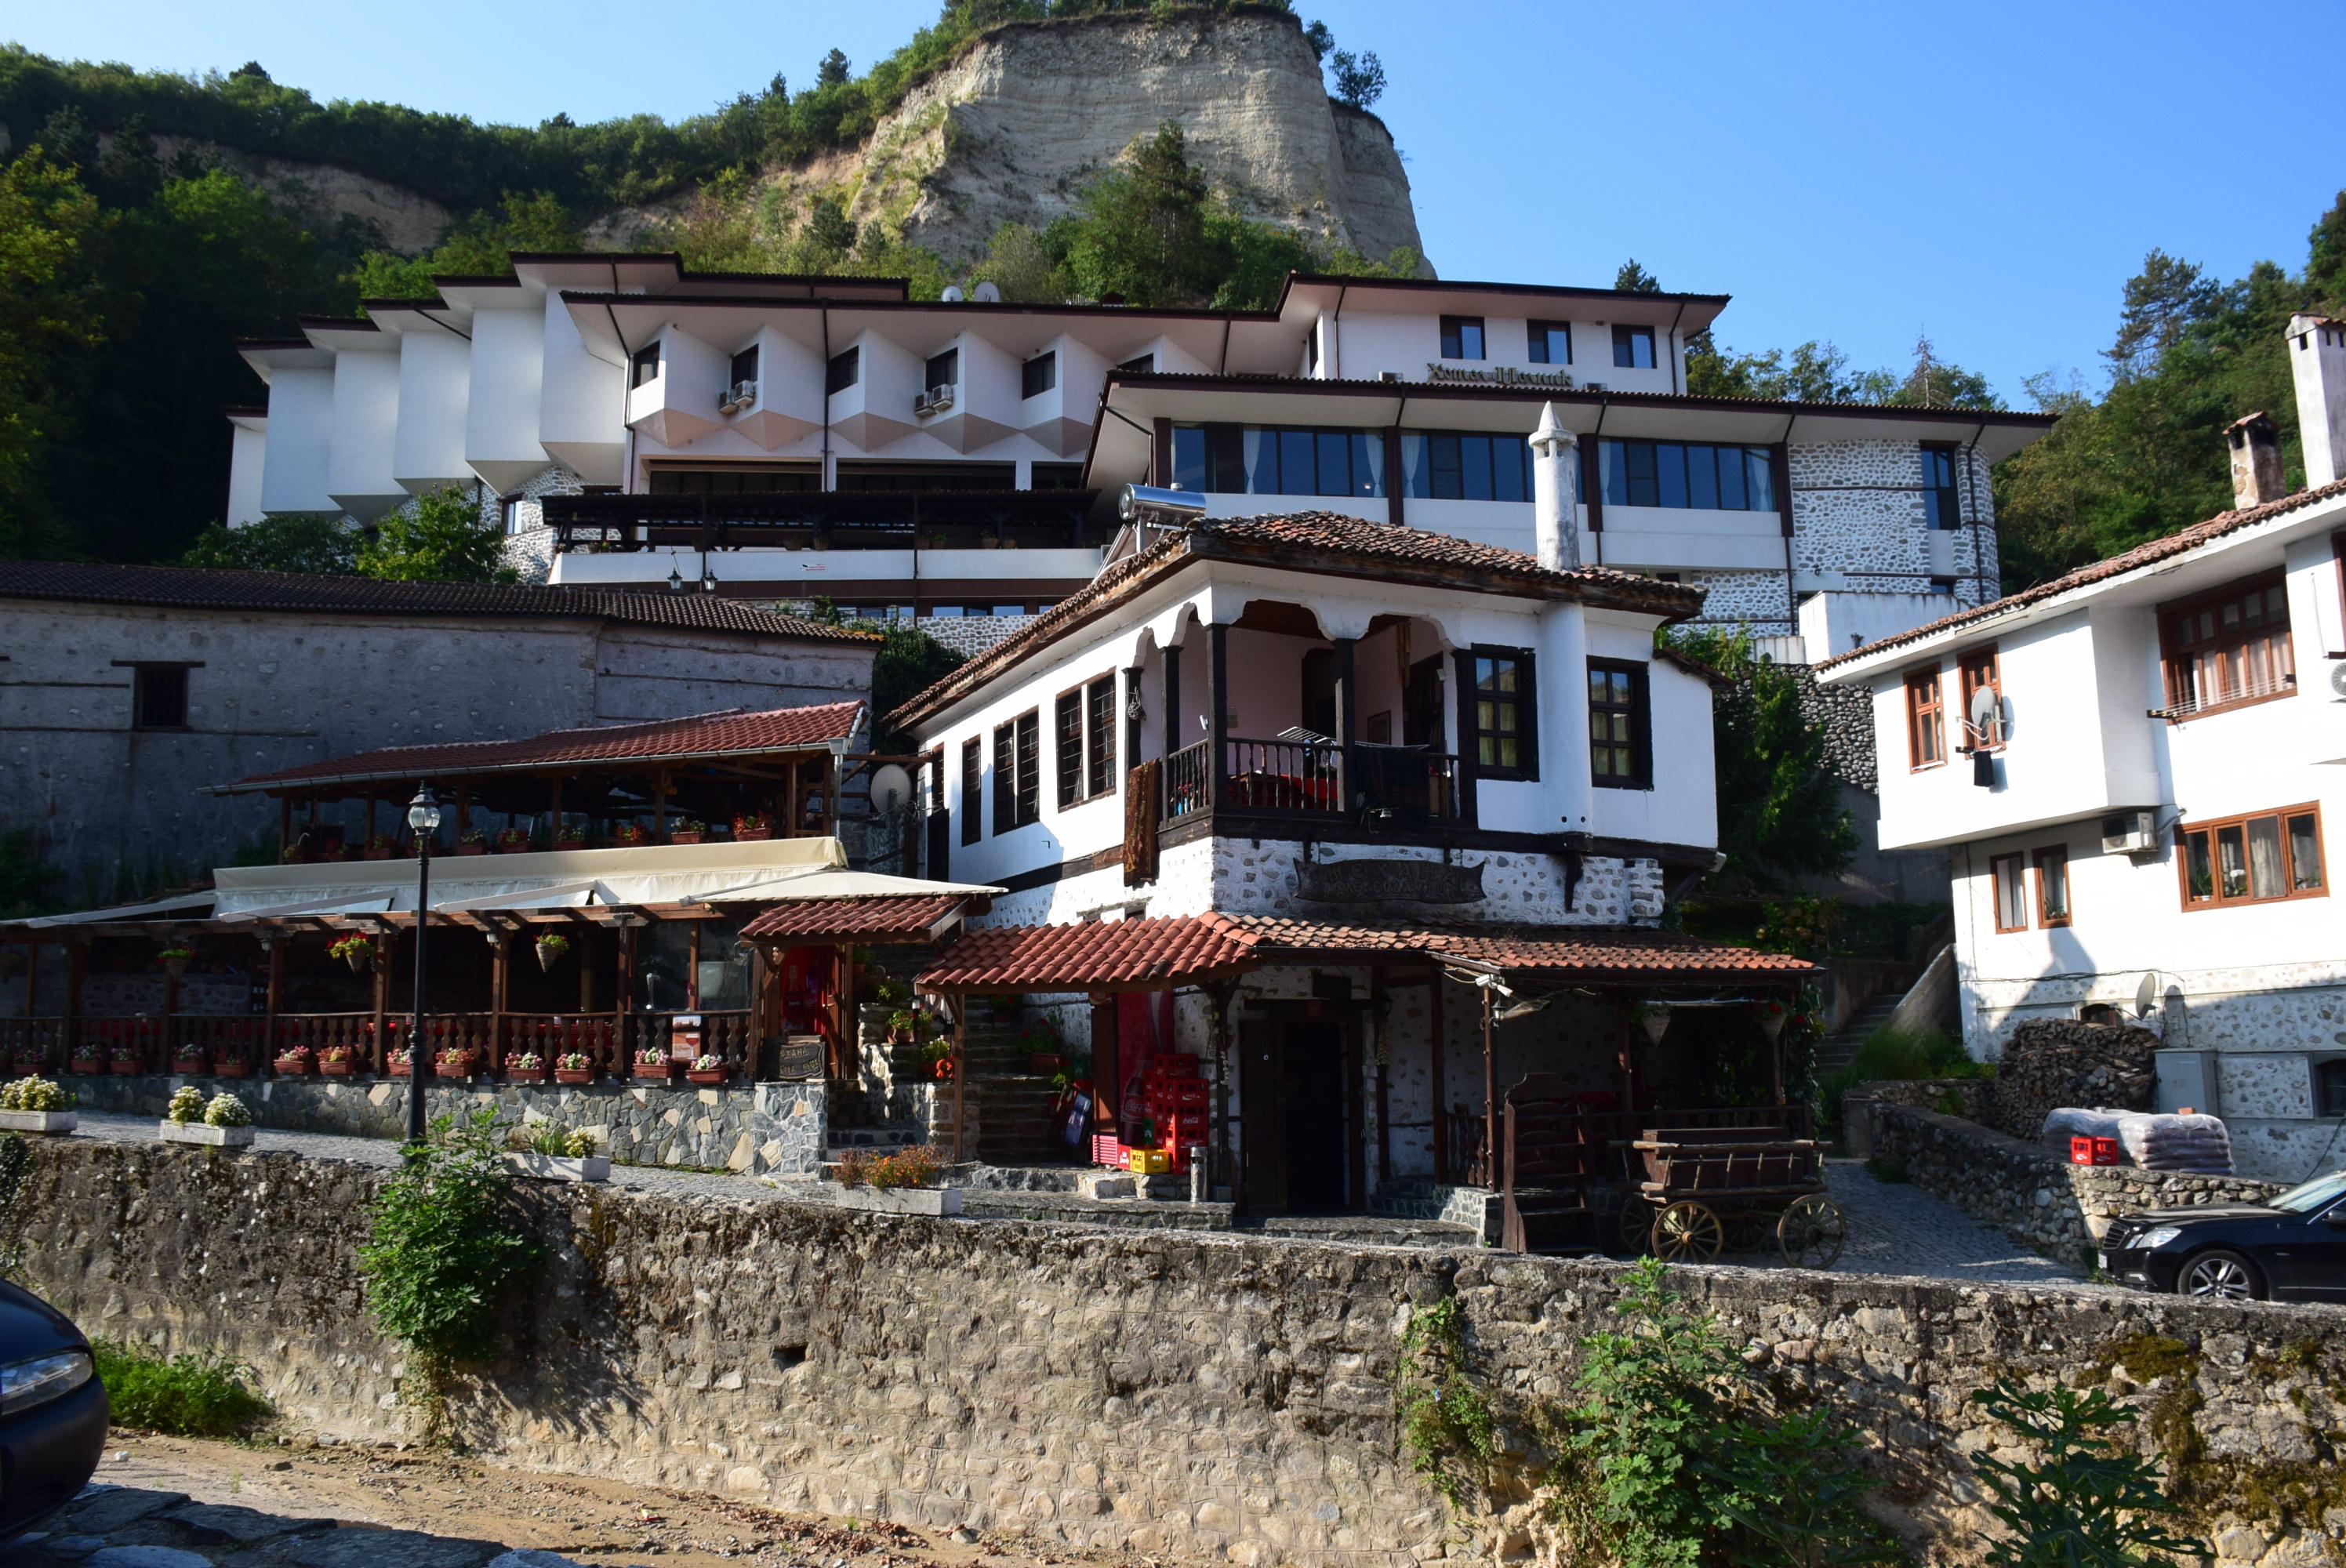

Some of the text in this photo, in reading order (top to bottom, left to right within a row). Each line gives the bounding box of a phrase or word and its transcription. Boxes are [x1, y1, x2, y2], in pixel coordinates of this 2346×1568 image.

[1427, 362, 1487, 382] Хотел
[1327, 862, 1456, 884] МЕХАНА
[779, 1047, 808, 1058] ЕХАНА
